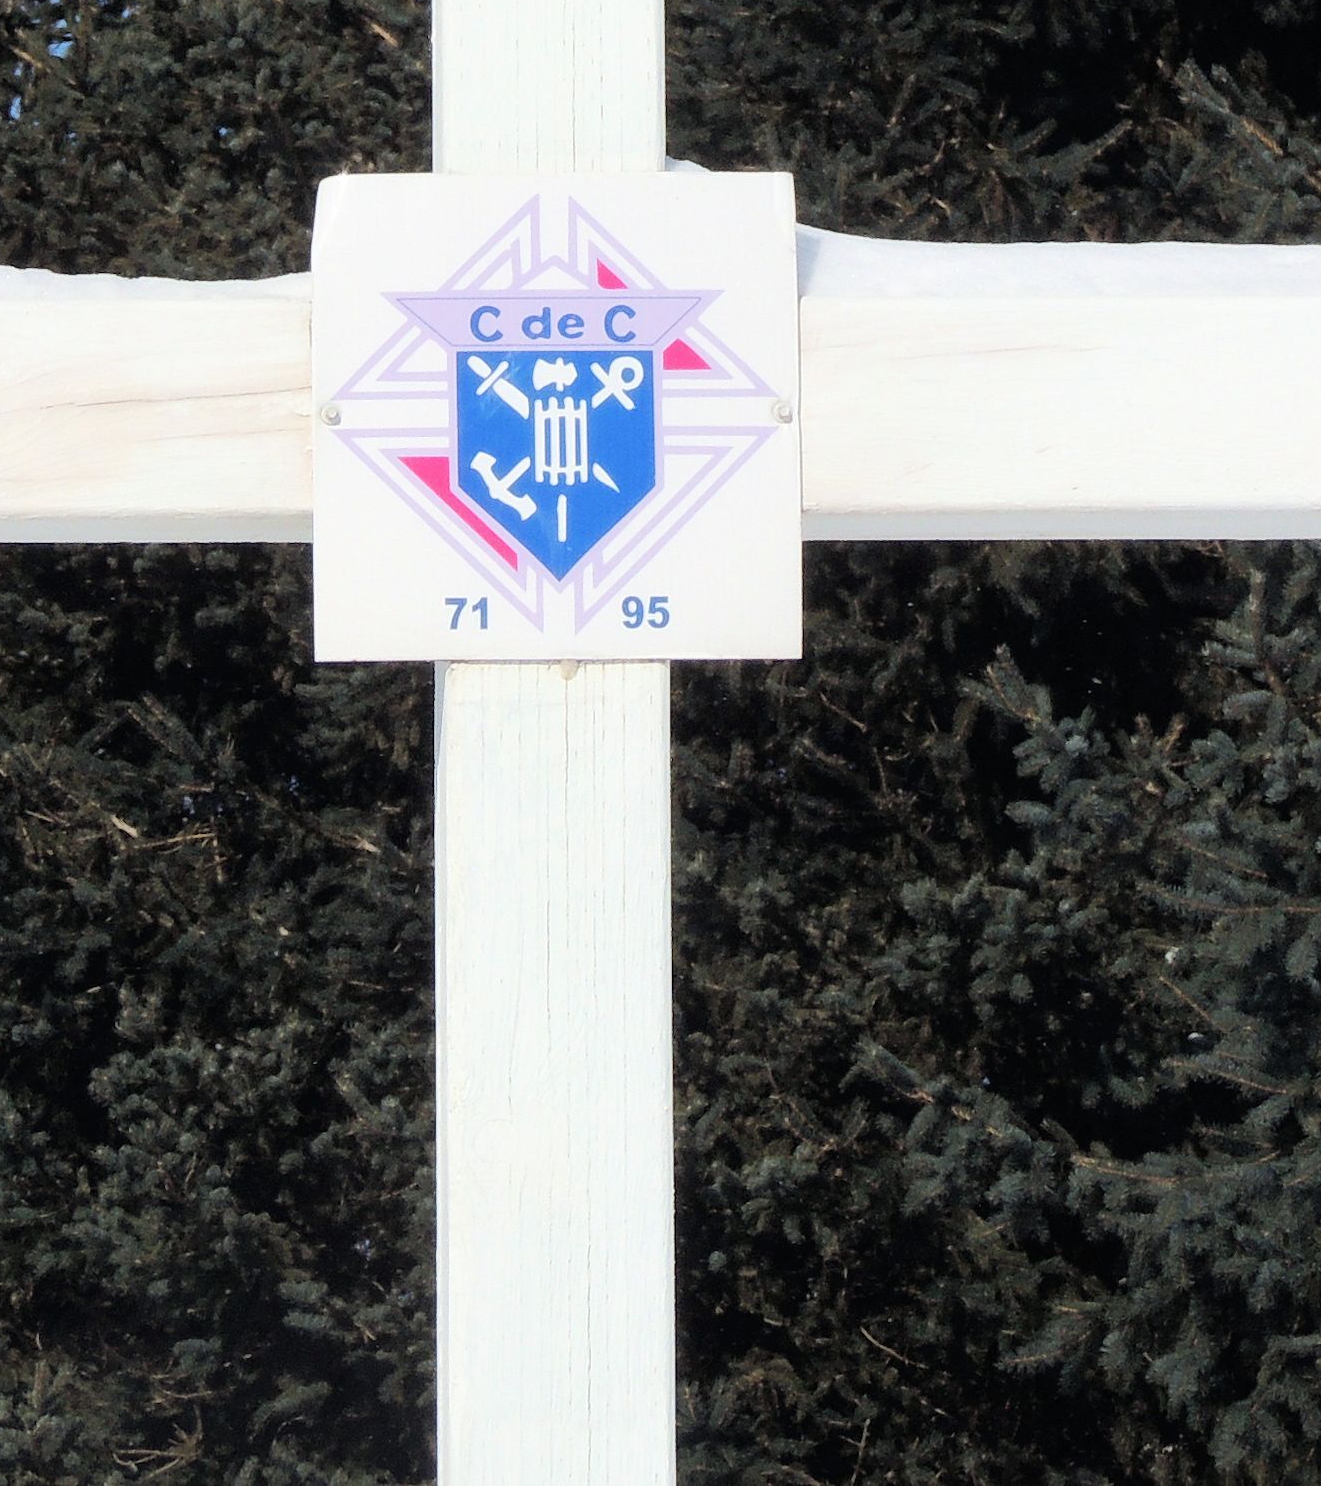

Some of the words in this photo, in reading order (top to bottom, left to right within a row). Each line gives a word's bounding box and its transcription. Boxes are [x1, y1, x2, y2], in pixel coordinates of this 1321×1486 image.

[469, 305, 504, 343] C
[521, 306, 585, 340] de
[603, 305, 637, 343] C
[444, 597, 490, 630] 71
[620, 596, 670, 630] 95
